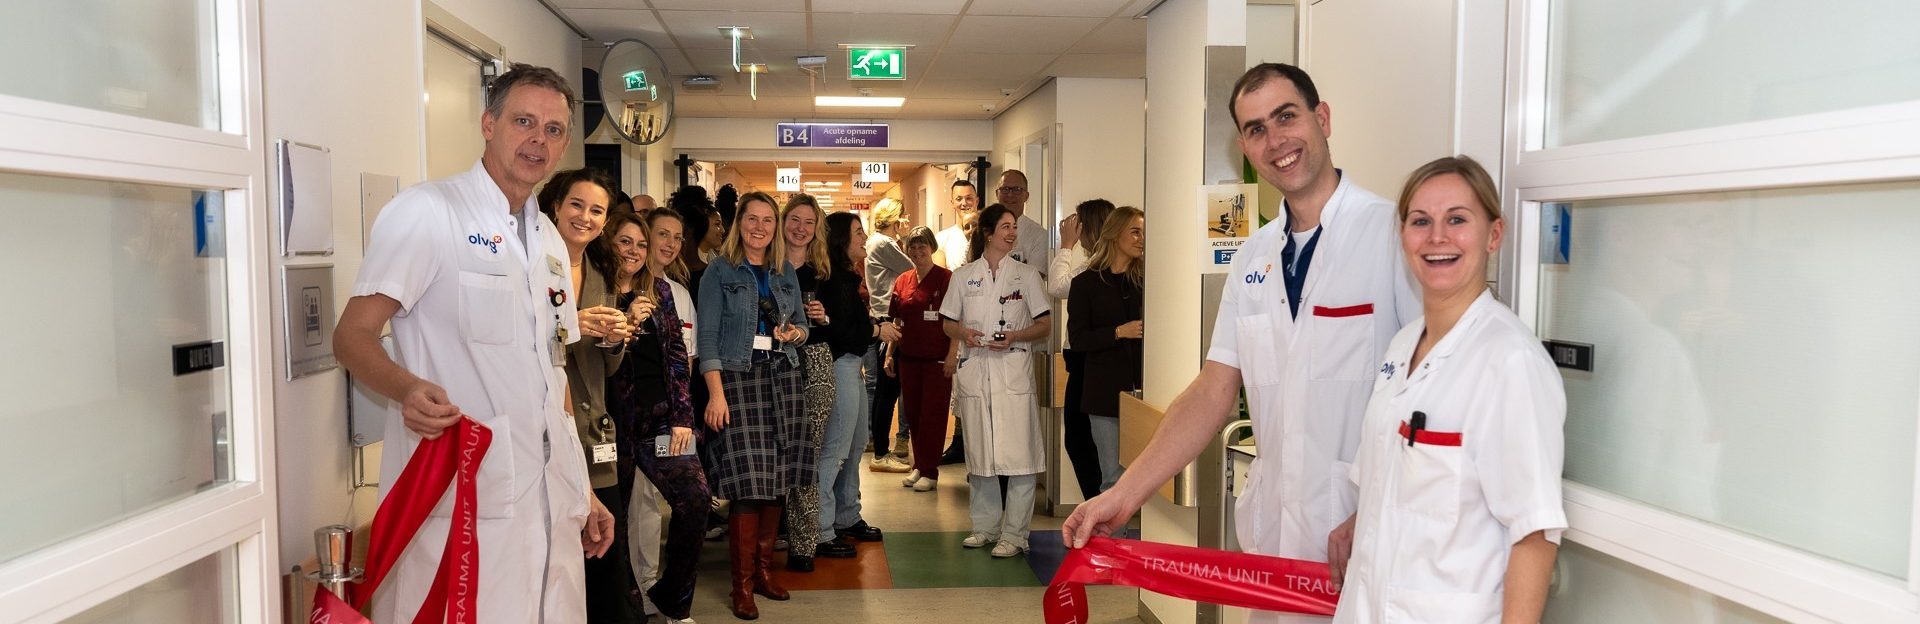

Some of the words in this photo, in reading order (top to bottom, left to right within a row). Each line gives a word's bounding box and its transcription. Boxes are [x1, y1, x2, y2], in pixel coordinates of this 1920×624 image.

[823, 127, 845, 135] Acute
[835, 137, 866, 146] afdeling
[865, 163, 887, 174] 401
[778, 175, 798, 185] 416
[853, 180, 872, 189] 402
[468, 233, 498, 254] olvg
[967, 279, 981, 288] olvg
[1245, 271, 1266, 284] olv
[462, 422, 481, 485] TRAUM
[462, 496, 472, 545] UNIT
[1141, 556, 1222, 580] TRAUMA
[1227, 567, 1274, 586] UNIT
[1285, 574, 1339, 595] TRAU
[456, 551, 471, 624] RAUMA
[1057, 581, 1074, 607] NIT
